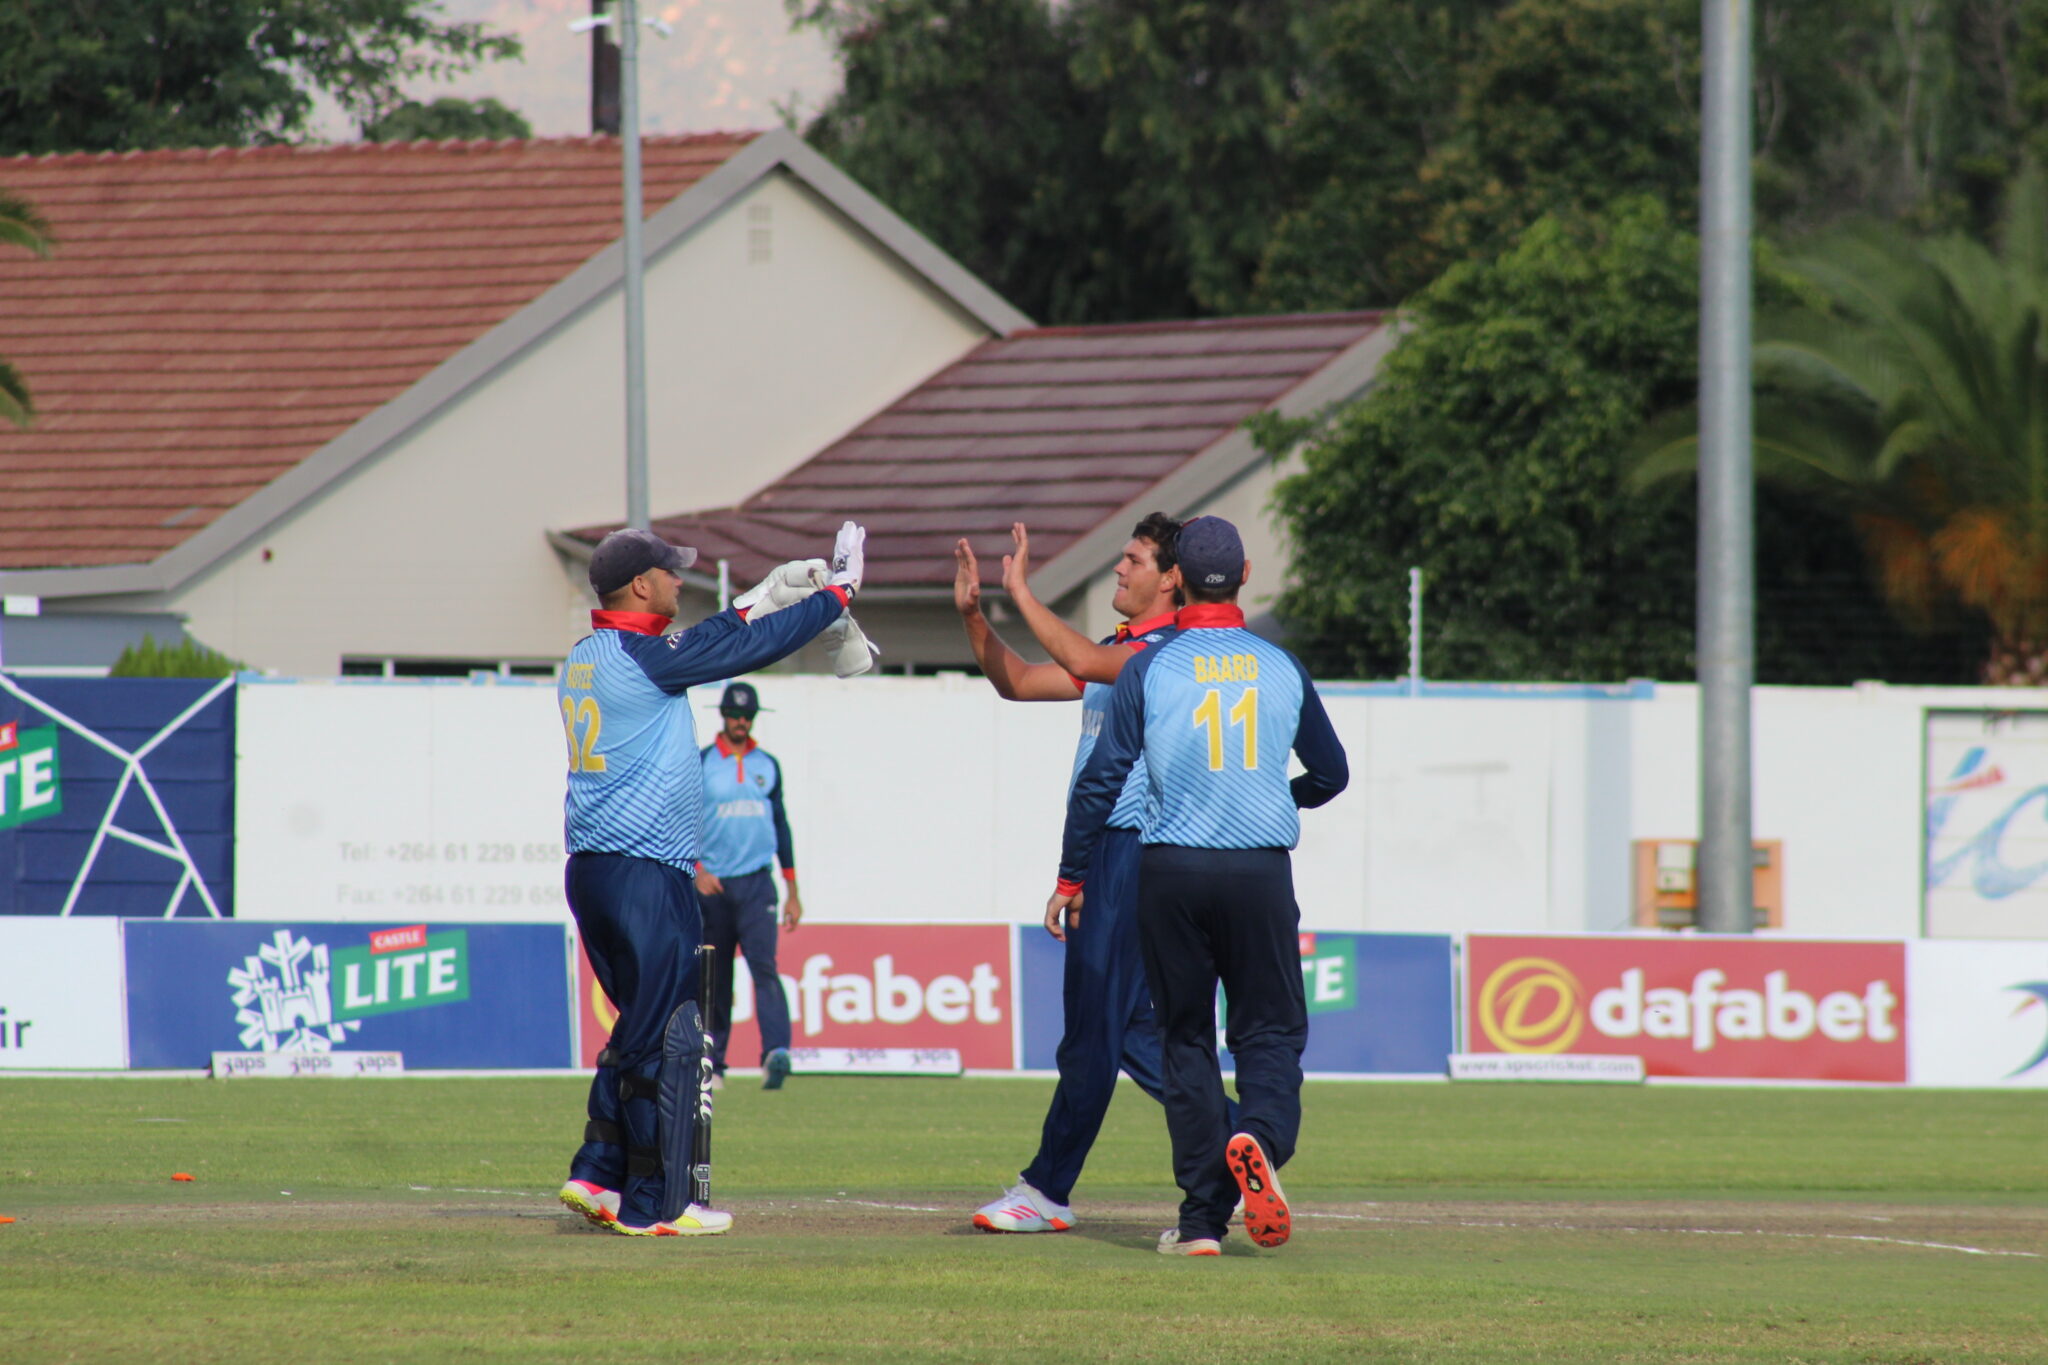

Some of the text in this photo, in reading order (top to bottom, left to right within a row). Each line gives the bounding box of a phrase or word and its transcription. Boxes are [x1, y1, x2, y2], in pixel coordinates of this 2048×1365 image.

[1193, 654, 1258, 683] BAARD
[1193, 687, 1258, 771] 11
[385, 842, 437, 863] +264
[443, 842, 468, 863] 61
[477, 842, 516, 863] 229
[450, 884, 475, 905] 61
[374, 929, 421, 949] CASTLE
[344, 948, 458, 1009] LITE
[1590, 967, 1898, 1052] dafabet
